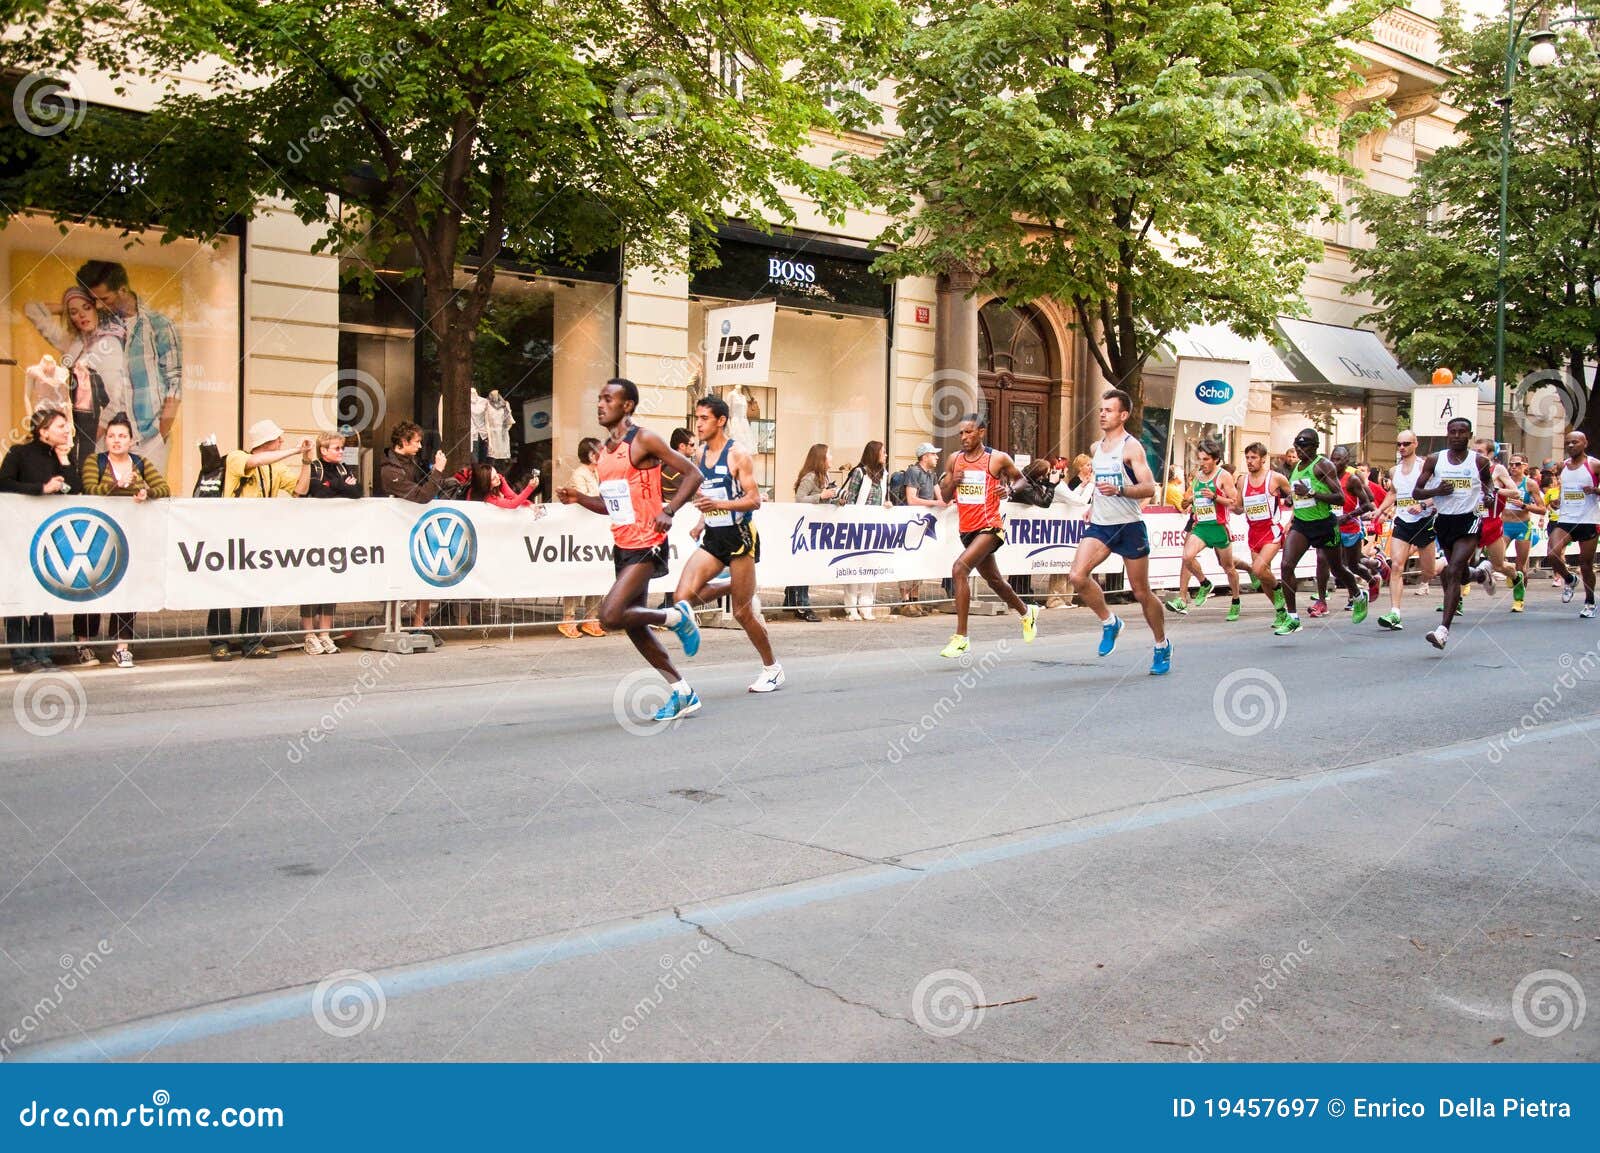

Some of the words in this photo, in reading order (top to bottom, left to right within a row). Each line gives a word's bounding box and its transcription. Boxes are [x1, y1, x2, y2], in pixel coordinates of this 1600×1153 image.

[768, 258, 816, 283] BOSS
[1338, 356, 1384, 381] Dior
[1199, 385, 1230, 400] Scholl
[524, 534, 679, 563] Volkswn
[808, 521, 908, 551] TRENTINA
[178, 538, 385, 574] Volkswagen
